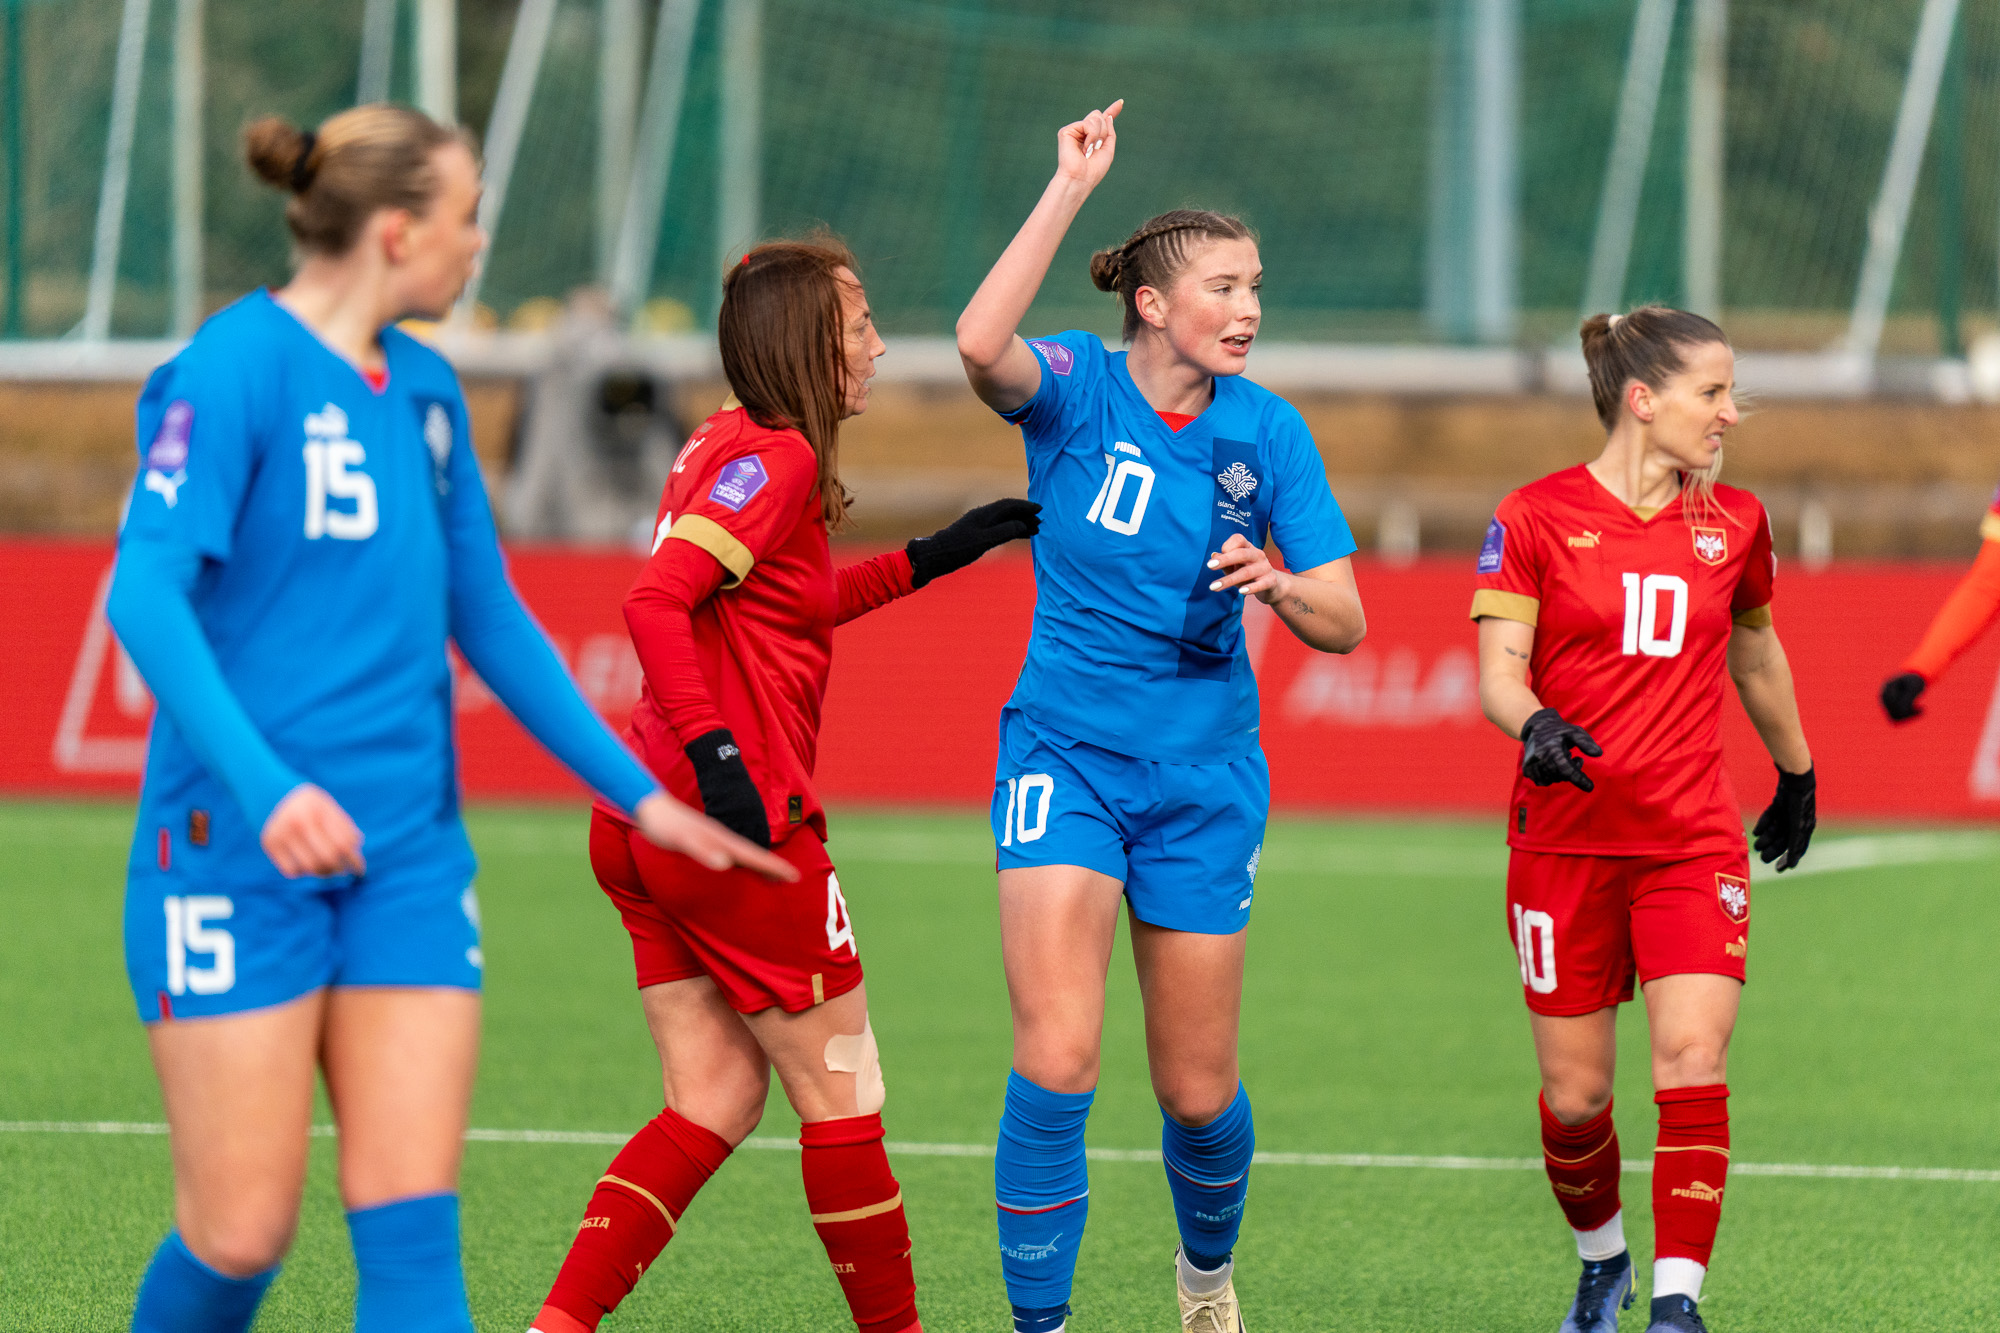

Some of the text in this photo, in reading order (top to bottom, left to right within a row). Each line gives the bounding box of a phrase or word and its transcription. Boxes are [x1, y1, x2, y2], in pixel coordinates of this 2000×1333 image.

[302, 439, 379, 540] 15
[1114, 441, 1141, 458] PUMA
[1085, 453, 1155, 536] 10
[1567, 536, 1596, 549] PUMA
[1622, 572, 1689, 659] 10
[1000, 773, 1055, 847] 10
[163, 894, 236, 997] 15
[825, 870, 858, 958] 4
[1513, 903, 1559, 995] 10
[1671, 1187, 1714, 1202] PUMA
